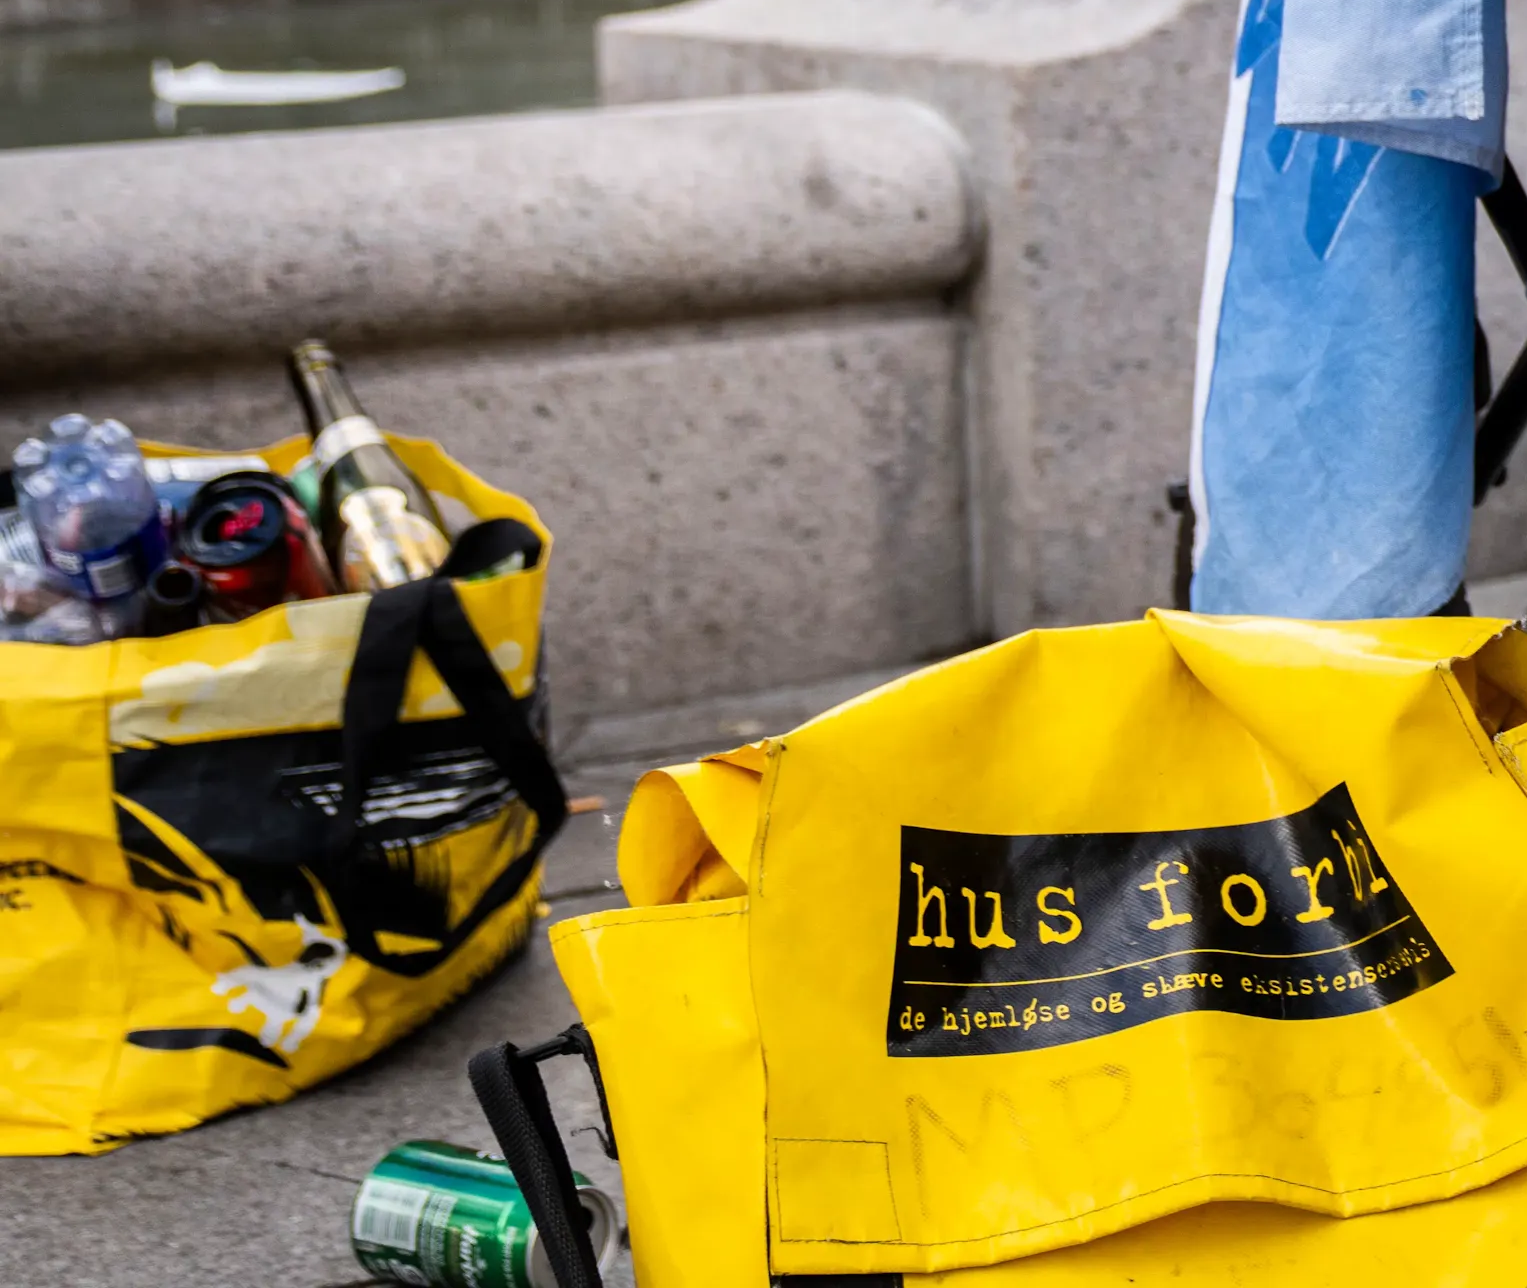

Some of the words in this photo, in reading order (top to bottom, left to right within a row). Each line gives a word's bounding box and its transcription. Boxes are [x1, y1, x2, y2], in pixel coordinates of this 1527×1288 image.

[908, 862, 1083, 949] hus
[1138, 819, 1389, 930] forbi
[899, 1005, 926, 1031] de
[942, 998, 1071, 1035] hjemløse
[1091, 992, 1126, 1014] og
[1142, 971, 1224, 998] skæve
